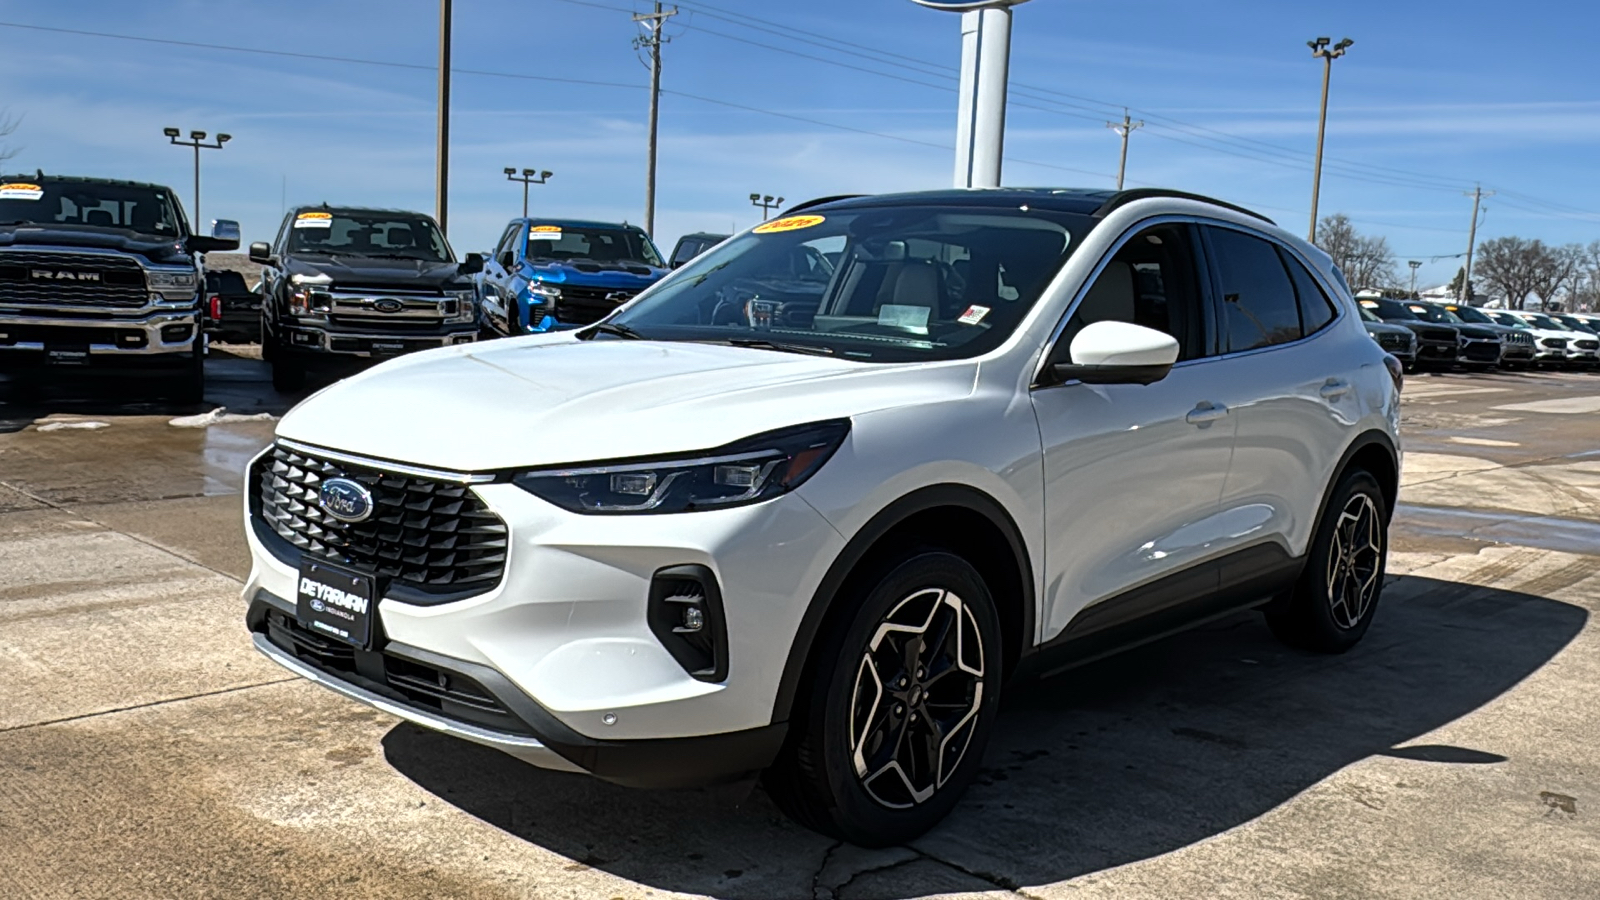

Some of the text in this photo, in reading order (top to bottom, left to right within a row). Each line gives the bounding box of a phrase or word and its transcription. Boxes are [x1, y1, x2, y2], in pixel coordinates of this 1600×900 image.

[31, 269, 100, 281] RAM
[326, 486, 356, 513] Ford
[299, 577, 369, 614] DEYARMAN
[325, 606, 355, 621] INDIANOLA
